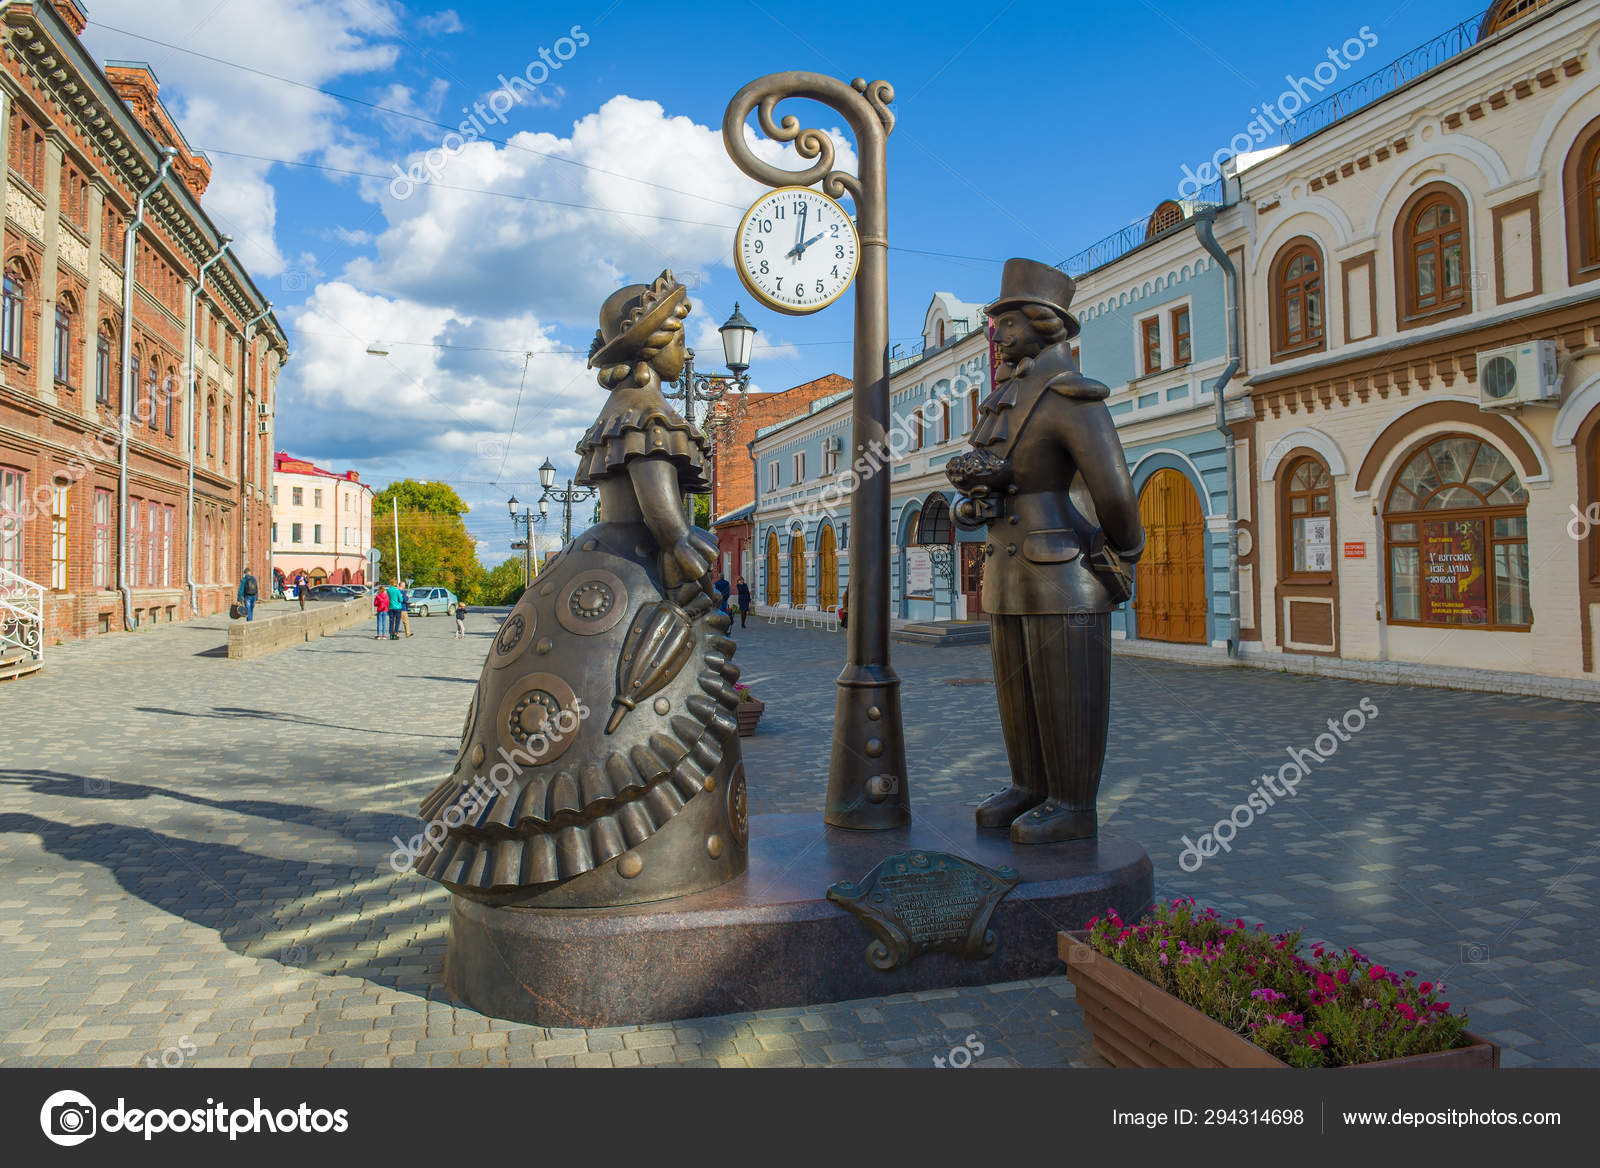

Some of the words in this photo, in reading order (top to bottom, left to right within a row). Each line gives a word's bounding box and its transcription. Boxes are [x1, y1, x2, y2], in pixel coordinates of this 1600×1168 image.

[775, 205, 785, 220] 11
[793, 201, 808, 215] 12
[817, 208, 822, 222] 1
[758, 219, 772, 233] 10
[830, 224, 839, 238] 2
[754, 240, 763, 254] 9
[835, 245, 845, 259] 3
[760, 260, 769, 274] 8
[830, 265, 839, 279] 4
[775, 276, 784, 291] 7
[795, 284, 804, 297] 6
[815, 279, 824, 293] 5
[1438, 553, 1472, 562] вятских
[1447, 565, 1469, 575] душа
[1430, 575, 1456, 584] живая
